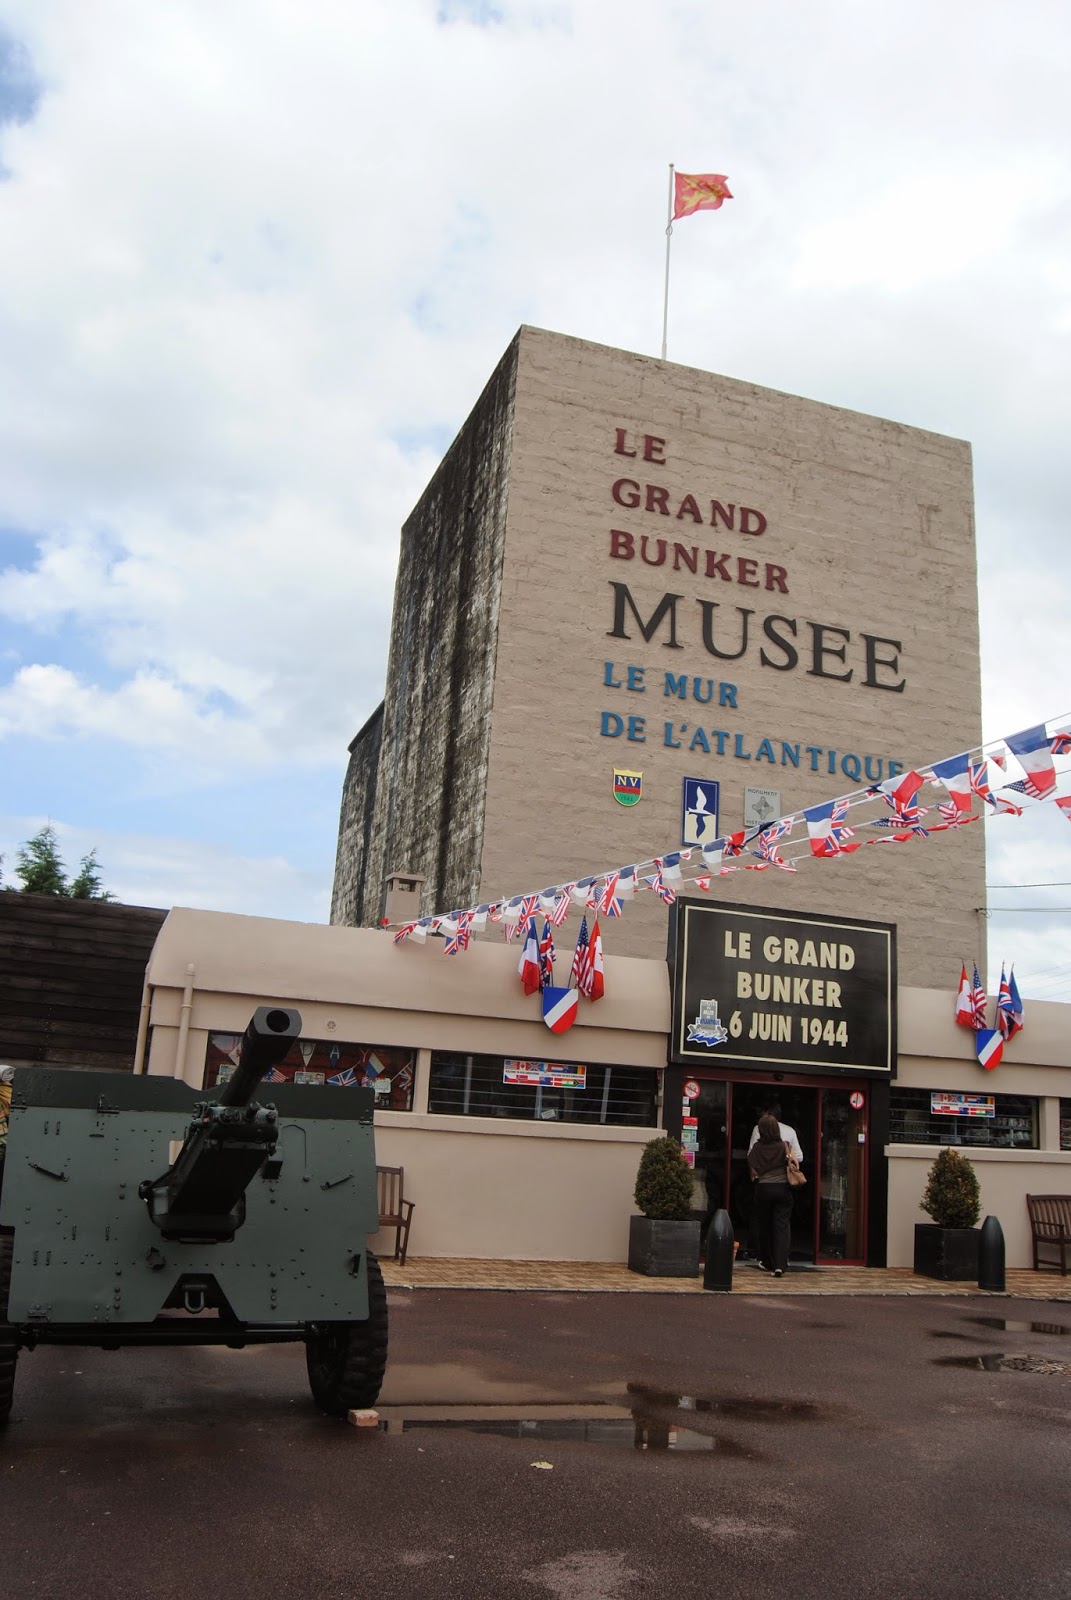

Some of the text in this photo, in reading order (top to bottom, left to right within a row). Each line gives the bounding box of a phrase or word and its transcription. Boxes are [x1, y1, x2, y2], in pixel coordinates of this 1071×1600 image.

[614, 427, 666, 464] LE
[612, 478, 767, 536] GRAND
[609, 529, 789, 593] BUNKER
[606, 580, 906, 693] MUSEE
[603, 662, 738, 708] LE MUR
[600, 711, 646, 742] DE
[747, 788, 778, 797] MONUMENT
[724, 930, 856, 971] LE GRAND
[737, 971, 842, 1008] BUNKER
[729, 1011, 848, 1047] 6 JUIN 1944
